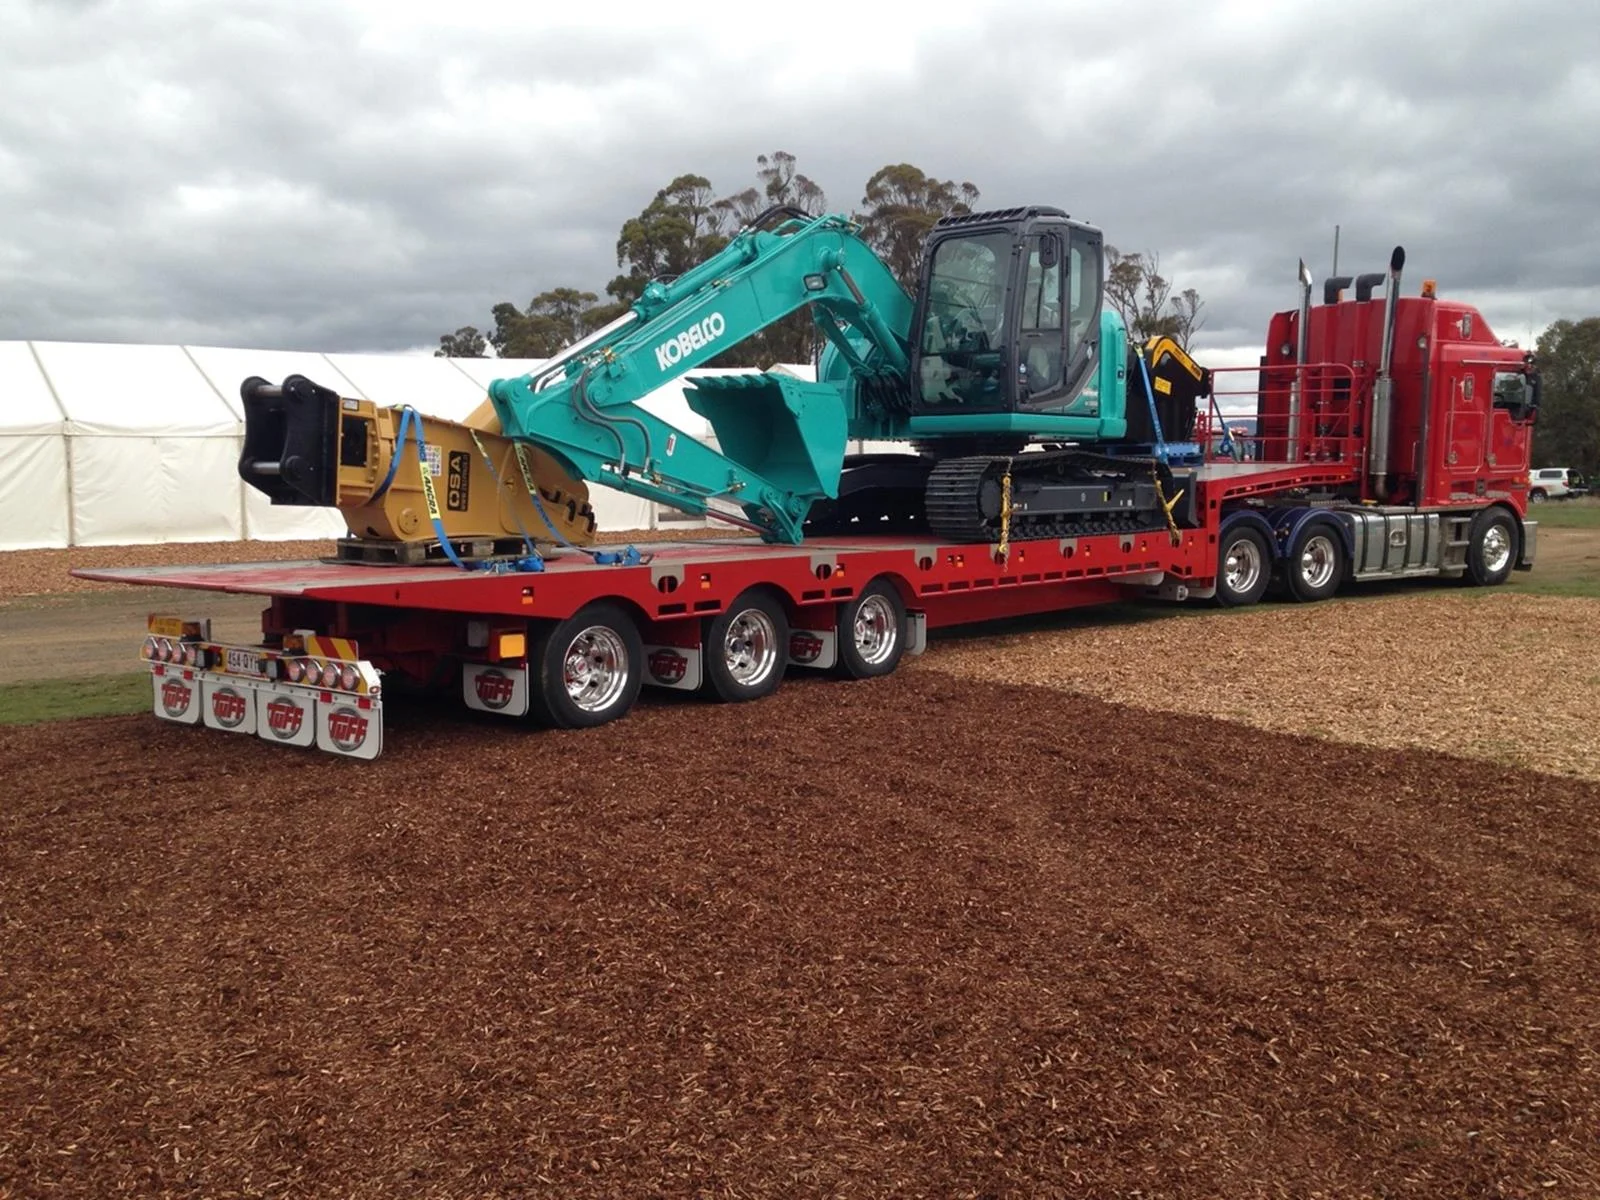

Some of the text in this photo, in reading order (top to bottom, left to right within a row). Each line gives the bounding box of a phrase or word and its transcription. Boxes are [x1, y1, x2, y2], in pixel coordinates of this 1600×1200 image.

[655, 312, 725, 371] KOBELCO
[449, 456, 461, 507] OSA
[267, 702, 304, 730] TUFF
[328, 713, 369, 743] TUFF
